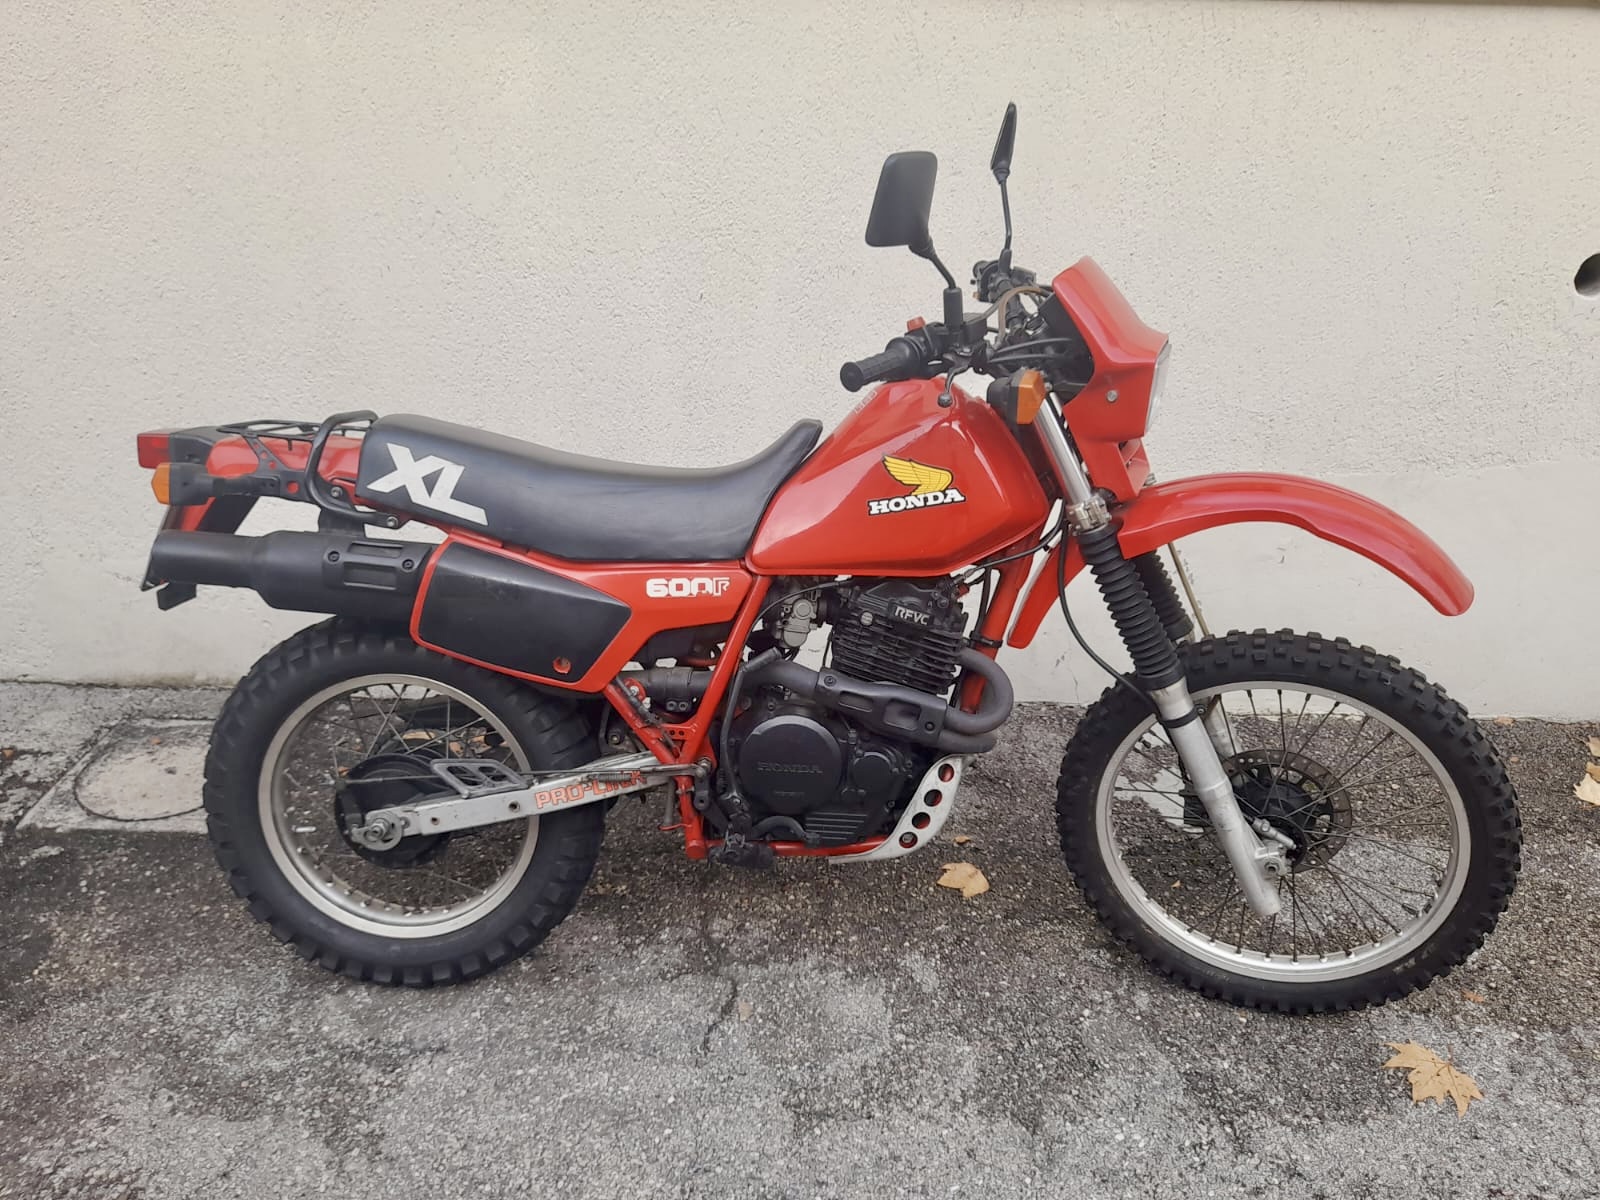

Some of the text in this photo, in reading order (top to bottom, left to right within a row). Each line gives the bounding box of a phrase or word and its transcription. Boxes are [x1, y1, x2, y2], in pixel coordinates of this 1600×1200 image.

[366, 442, 488, 526] XL
[868, 488, 965, 515] HONDA
[894, 606, 930, 625] RFVC
